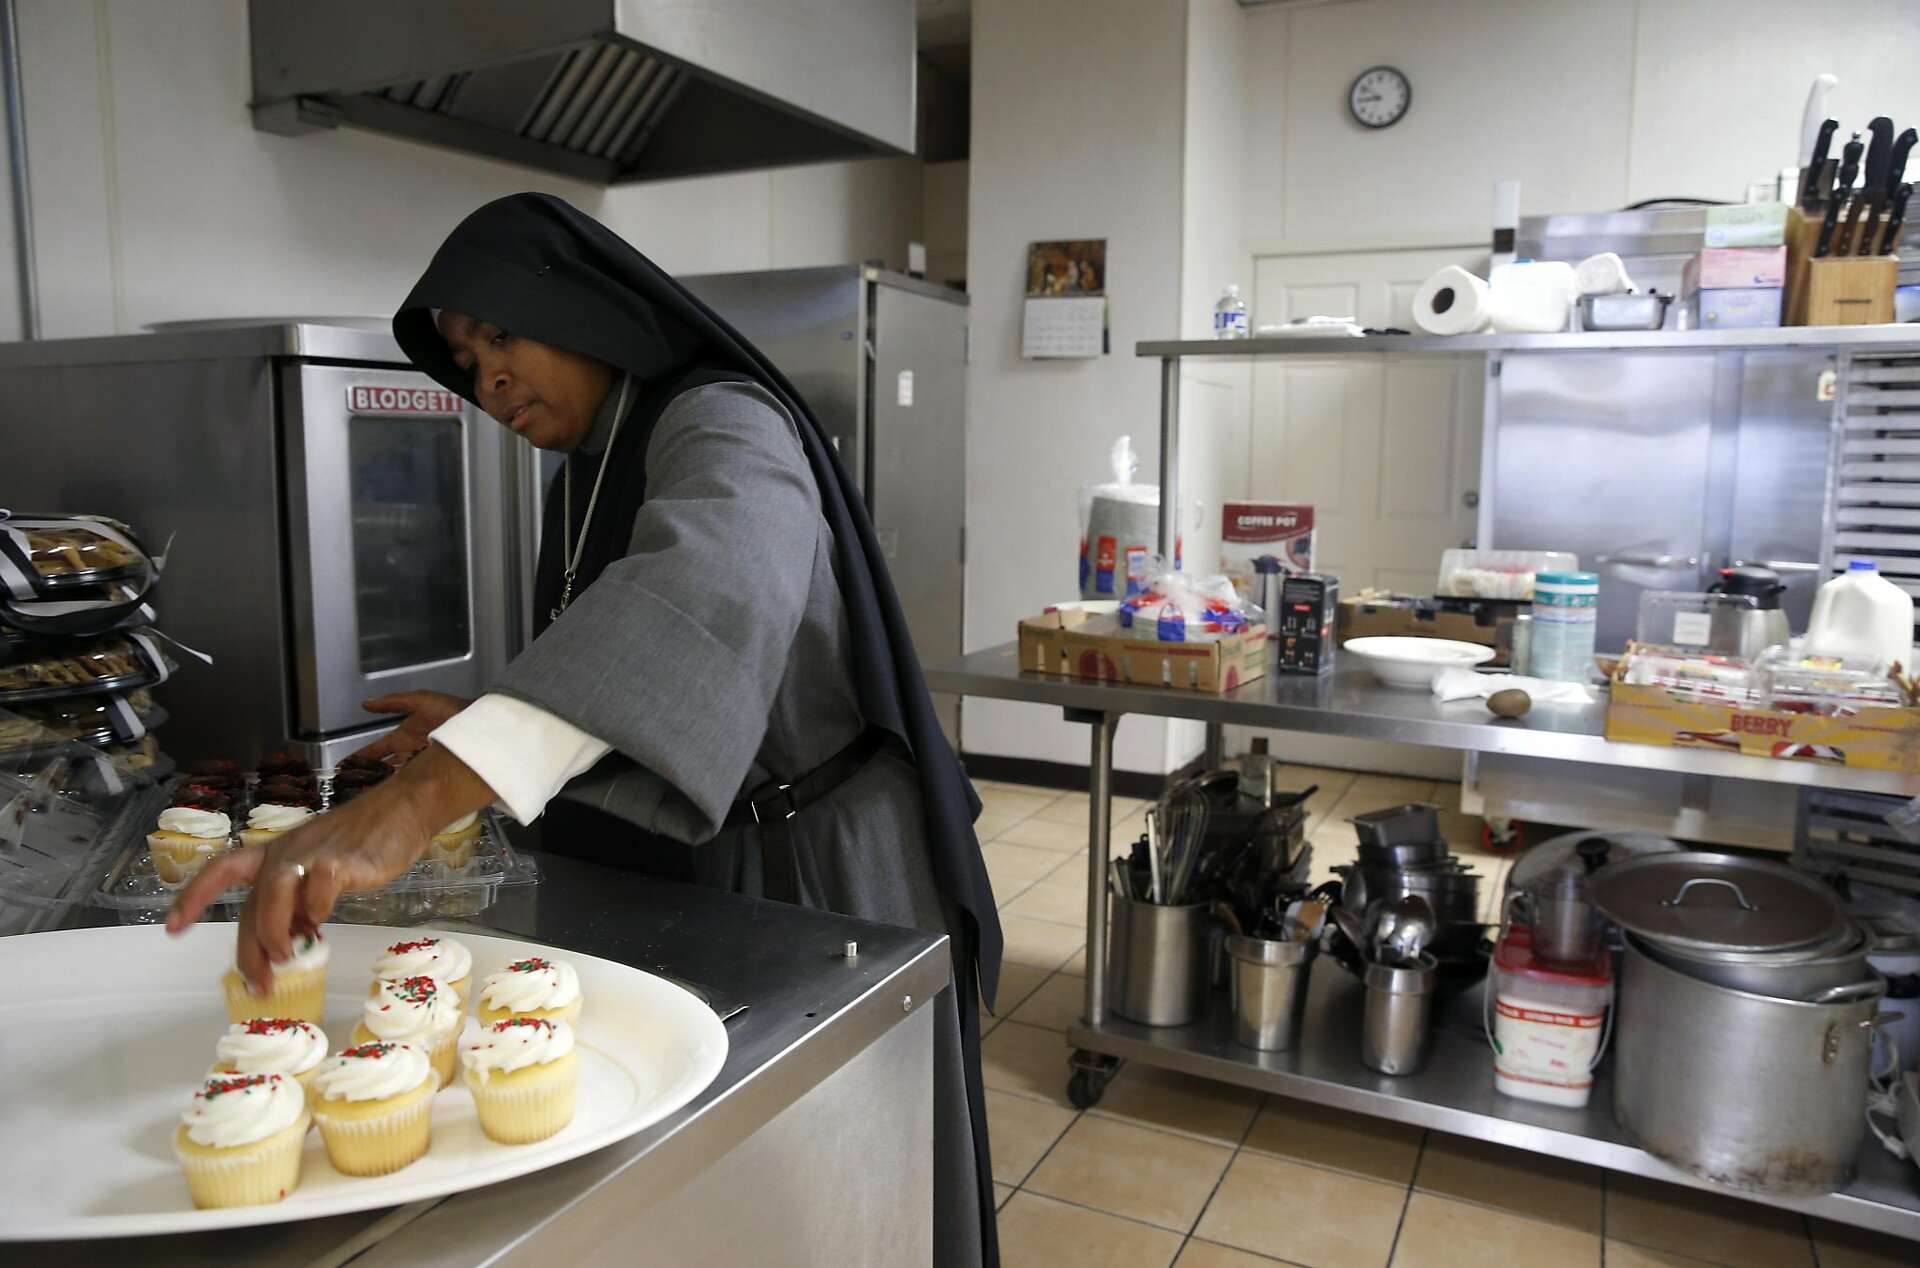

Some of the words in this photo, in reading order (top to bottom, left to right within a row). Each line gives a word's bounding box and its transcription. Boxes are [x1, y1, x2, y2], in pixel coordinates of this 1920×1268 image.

[356, 388, 460, 411] BLODGETT
[1238, 515, 1274, 527] COFFEE
[1275, 515, 1297, 527] POT
[1730, 714, 1793, 738] BERRY
